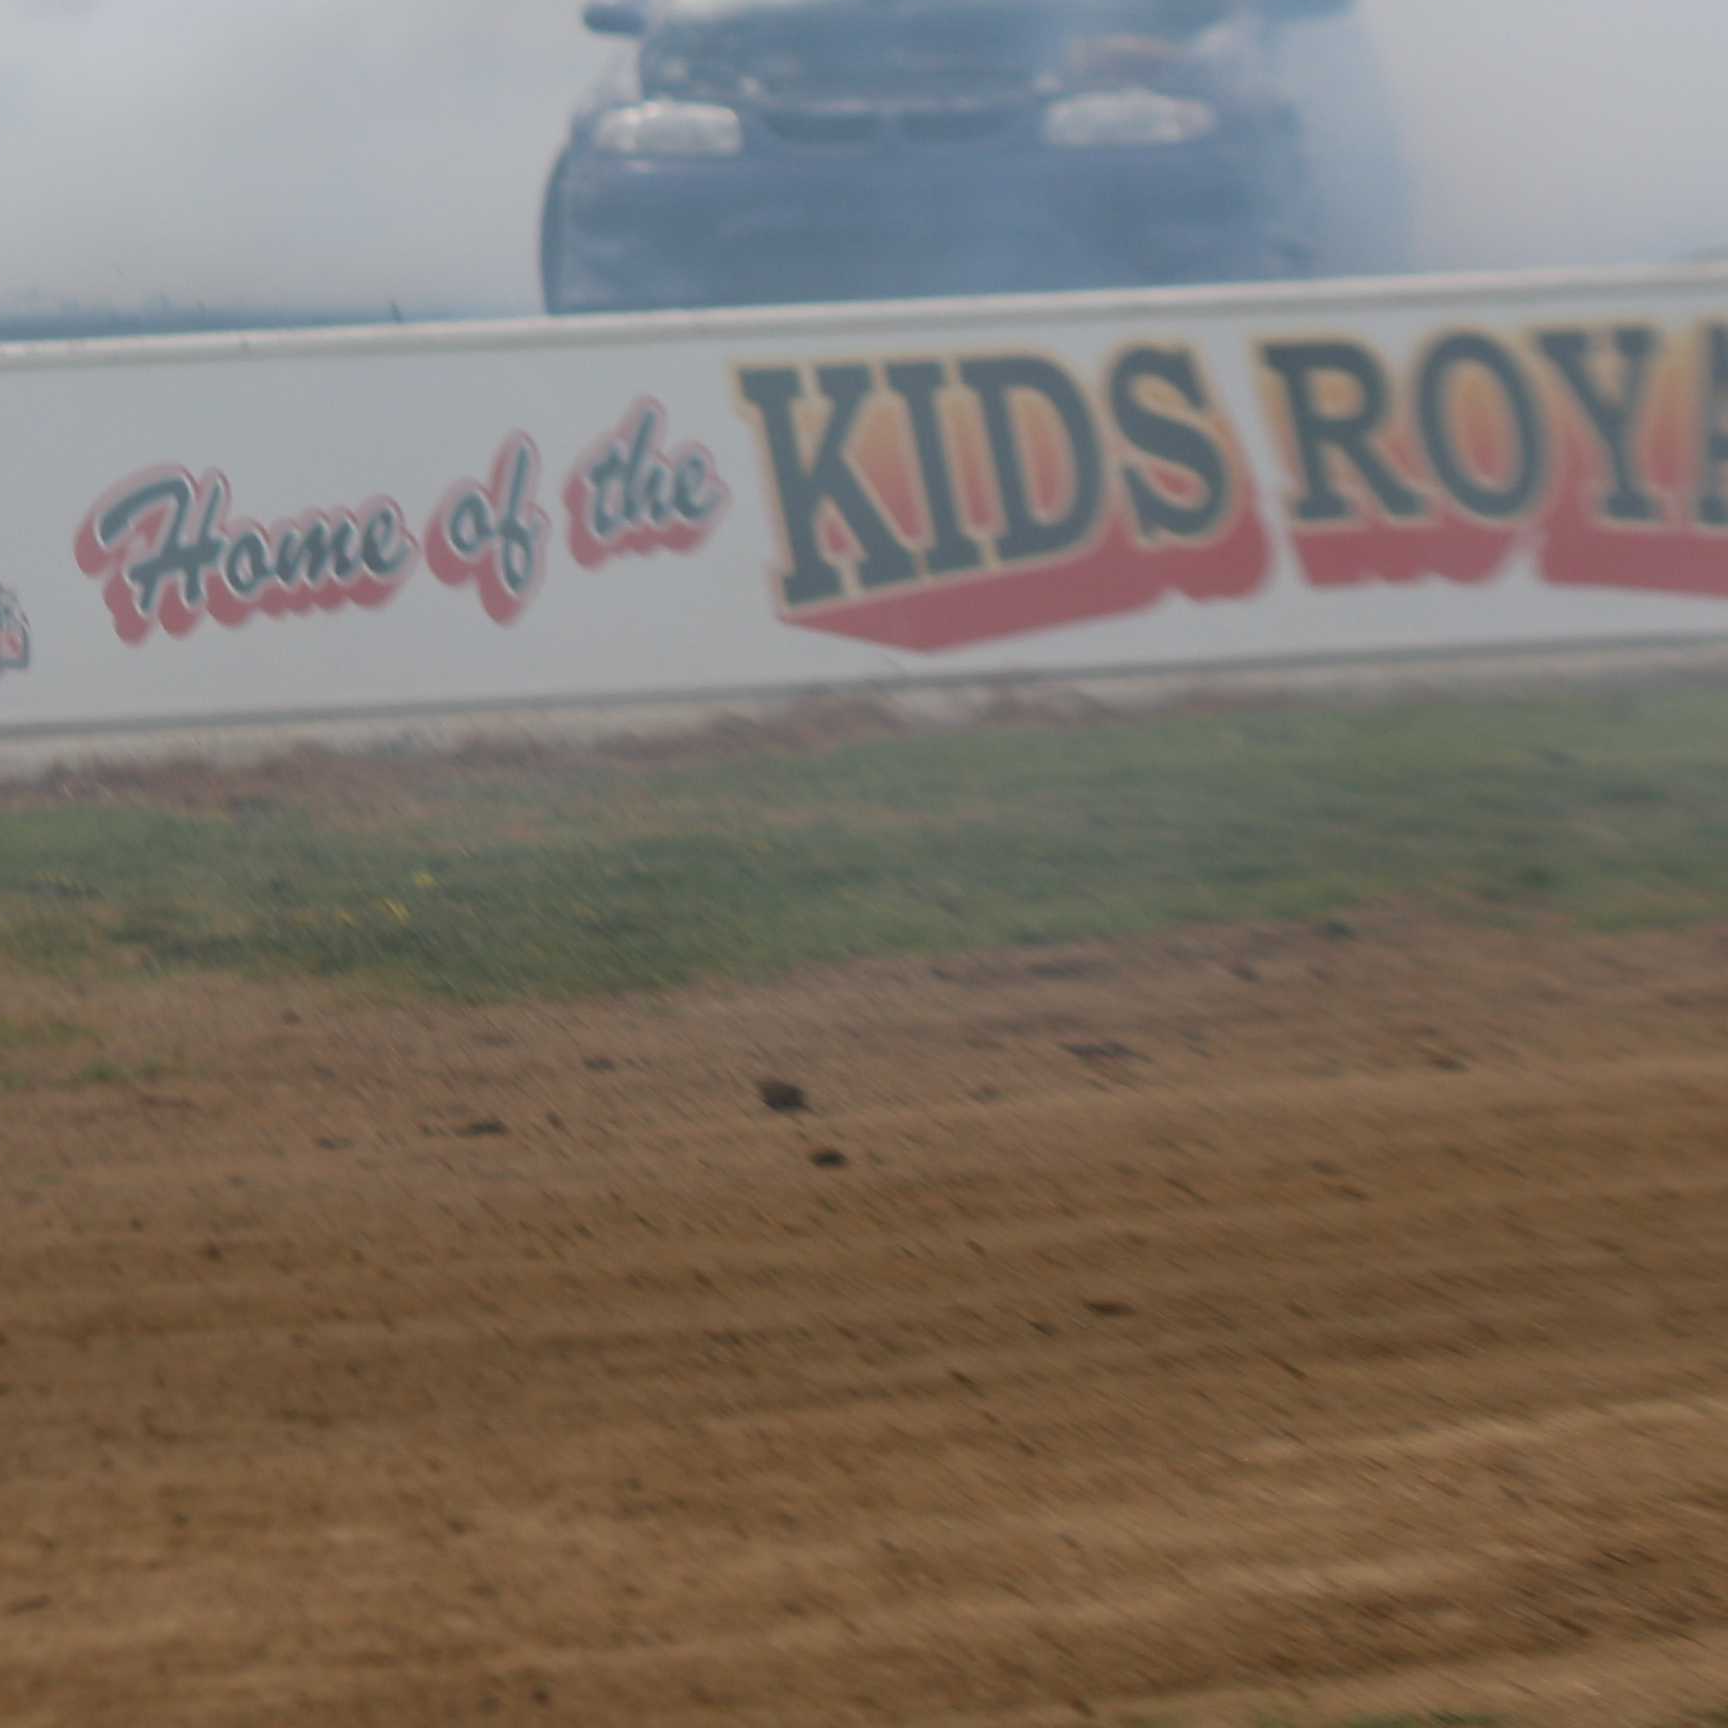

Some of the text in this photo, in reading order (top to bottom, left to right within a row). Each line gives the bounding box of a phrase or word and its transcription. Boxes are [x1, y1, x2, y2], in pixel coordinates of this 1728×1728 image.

[84, 400, 726, 634] Home of the
[734, 340, 1242, 614] KIDS
